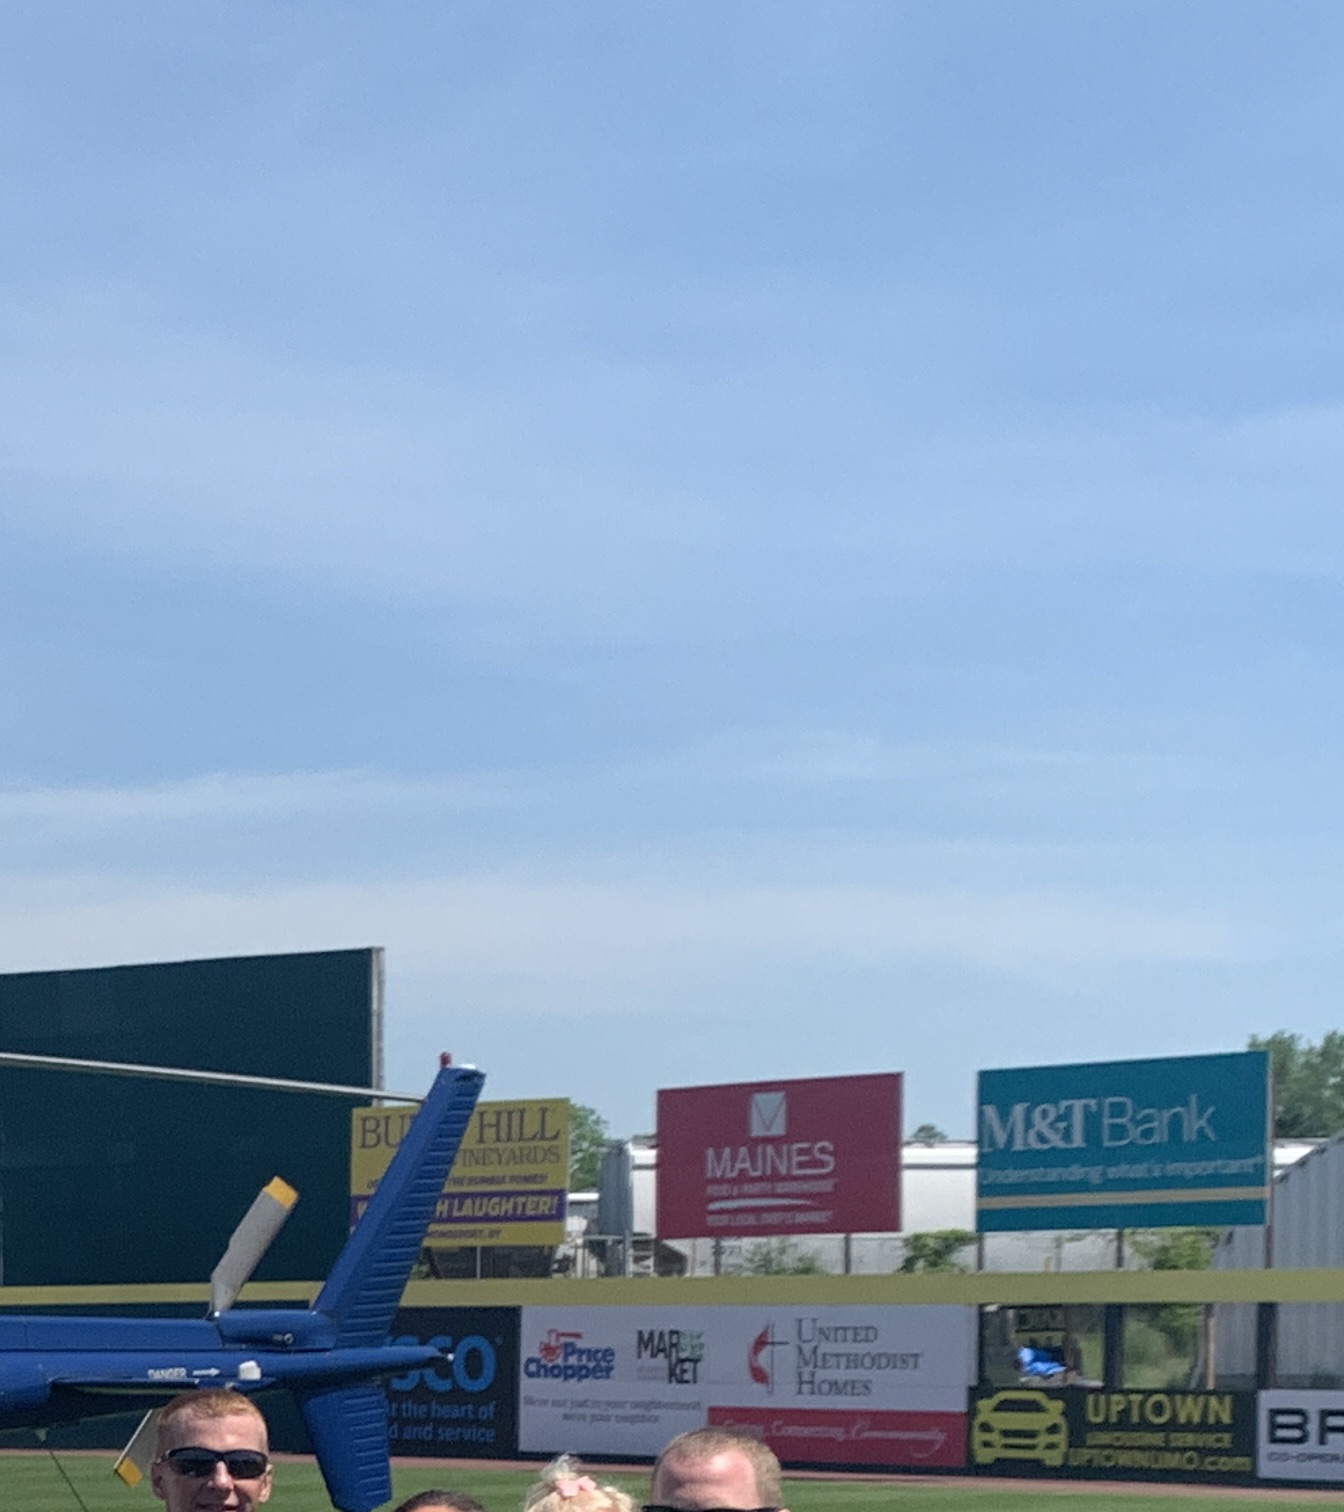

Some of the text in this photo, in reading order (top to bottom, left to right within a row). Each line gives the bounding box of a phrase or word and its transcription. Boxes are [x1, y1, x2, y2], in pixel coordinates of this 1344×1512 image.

[476, 1106, 561, 1144] HILL
[979, 1093, 1218, 1152] M&T Bank
[453, 1145, 560, 1168] INEYARDS
[705, 1140, 836, 1179] MAINES
[452, 1194, 559, 1217] LAUGHTER!
[795, 1317, 879, 1344] UNITED
[563, 1341, 616, 1364] Price
[795, 1345, 924, 1371] METHODIST
[147, 1367, 188, 1380] DANGER
[523, 1356, 616, 1382] Chopper
[795, 1370, 874, 1397] HOMES
[431, 1401, 475, 1418] heart
[1085, 1393, 1234, 1425] UPTOWN
[437, 1425, 496, 1442] service
